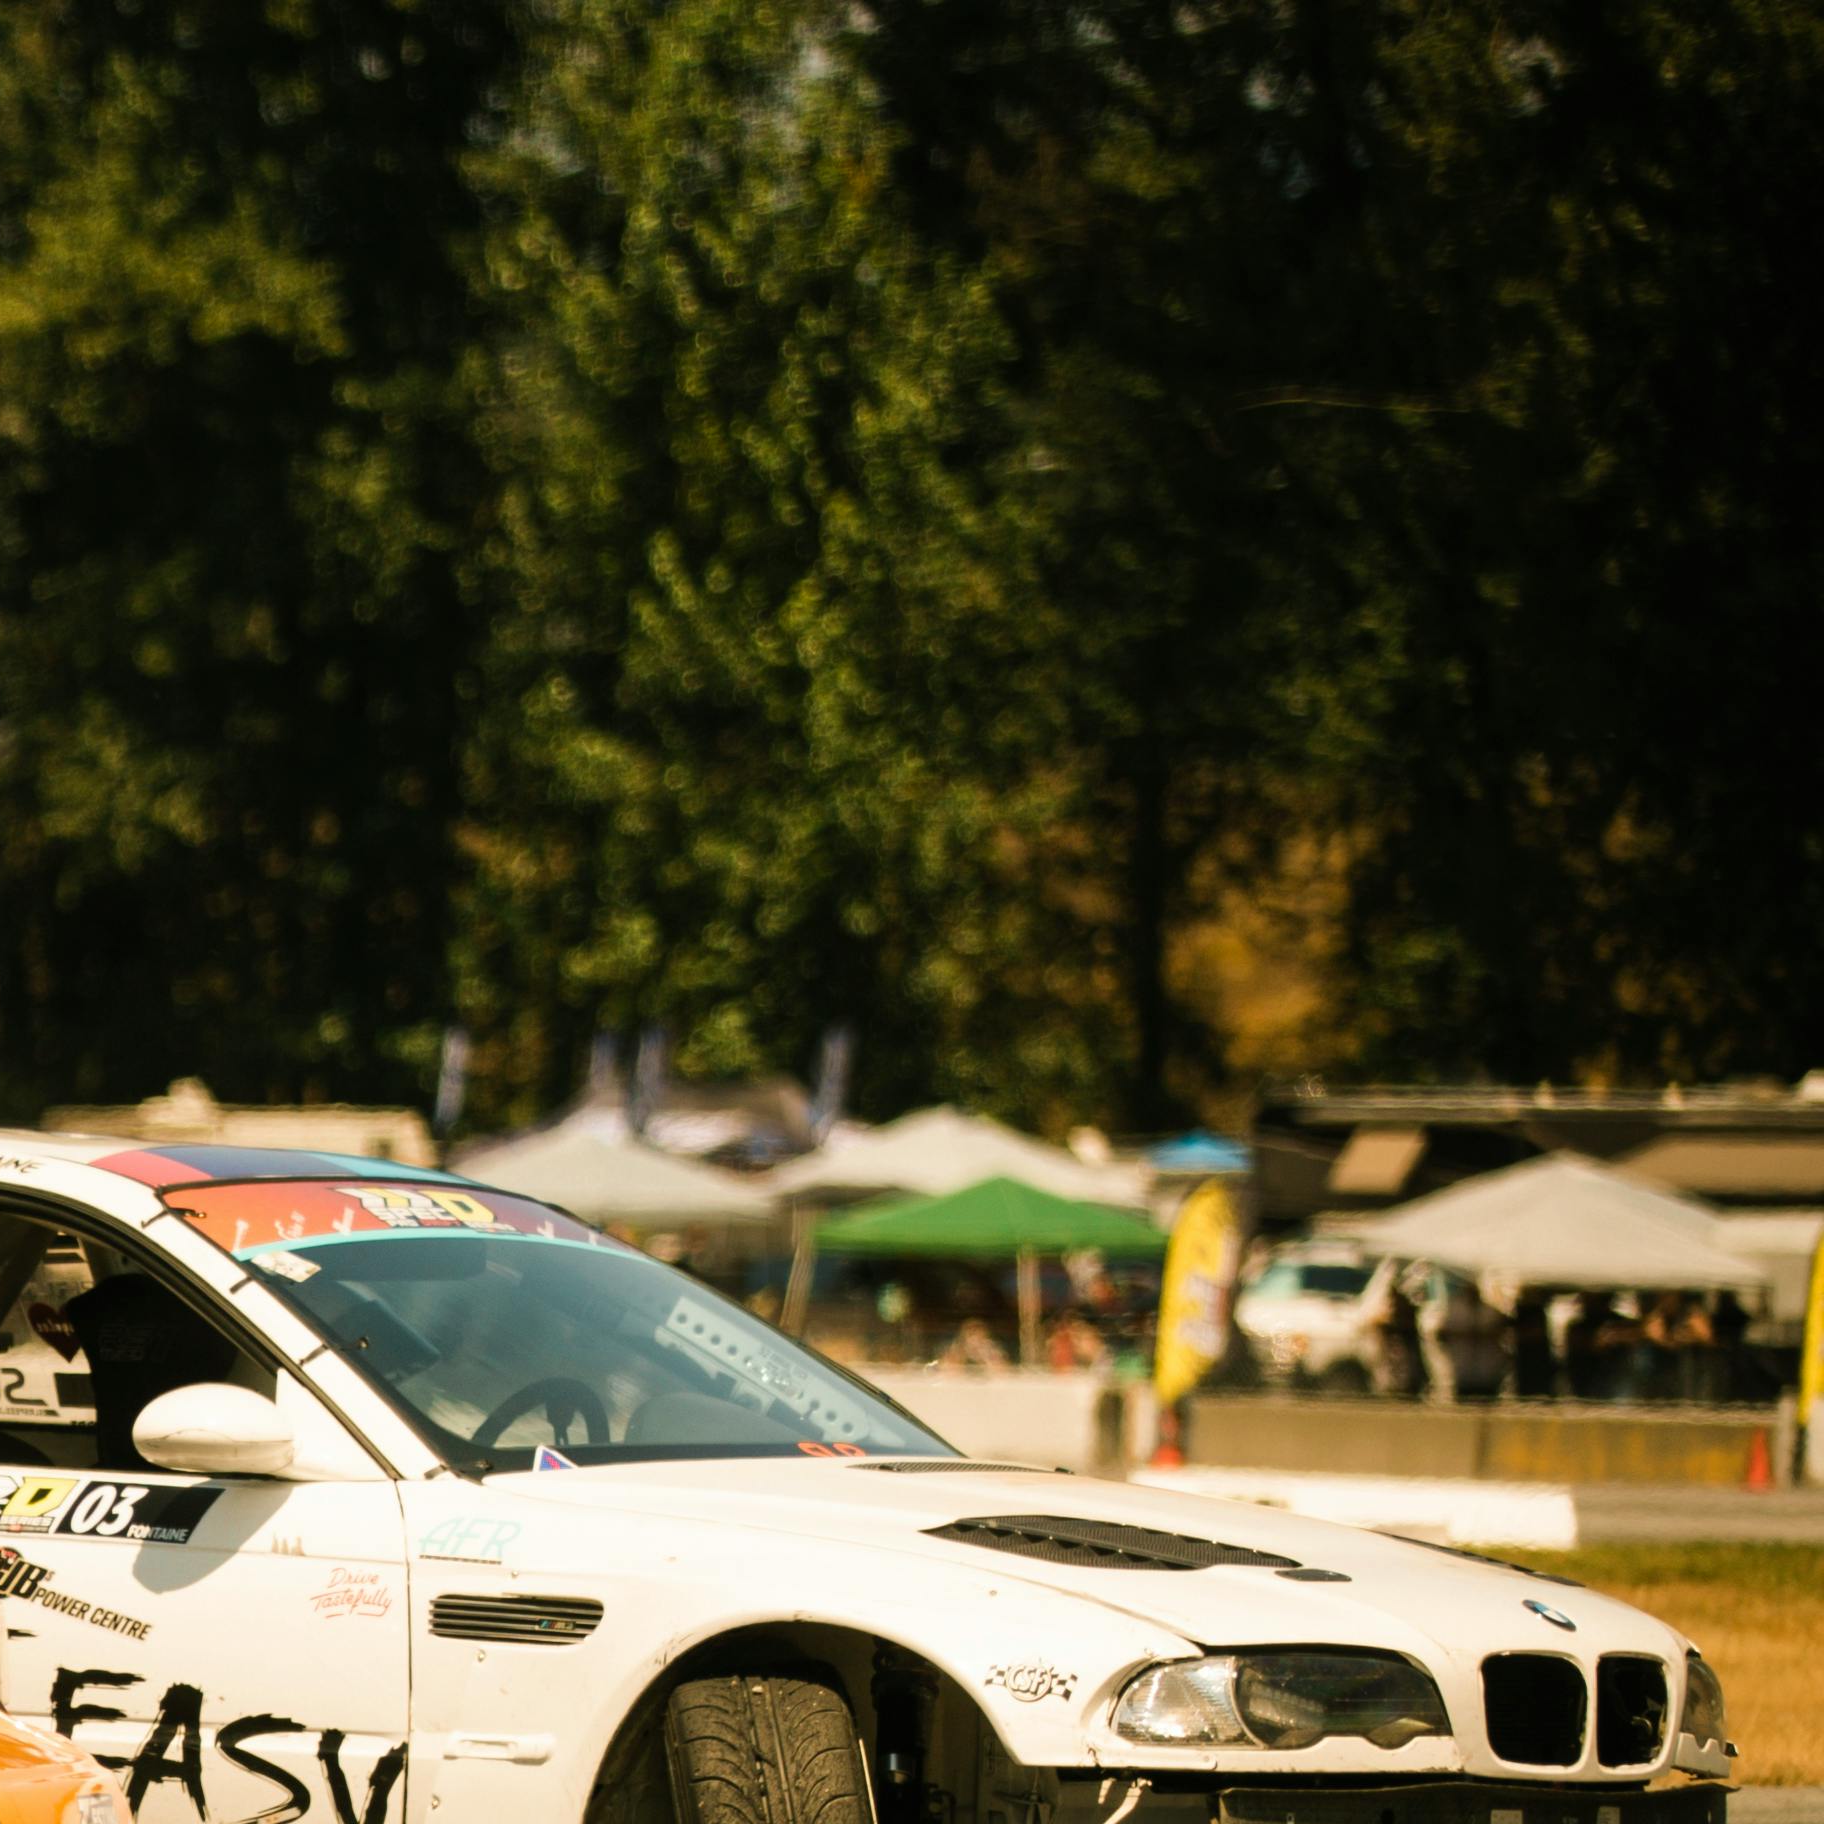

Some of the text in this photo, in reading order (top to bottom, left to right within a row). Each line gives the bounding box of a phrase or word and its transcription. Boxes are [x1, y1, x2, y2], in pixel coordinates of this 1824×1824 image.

[69, 1484, 150, 1536] 03
[125, 1524, 191, 1542] FONTAINE
[327, 1566, 381, 1589] Drive
[32, 1585, 153, 1642] POWER CENTRE
